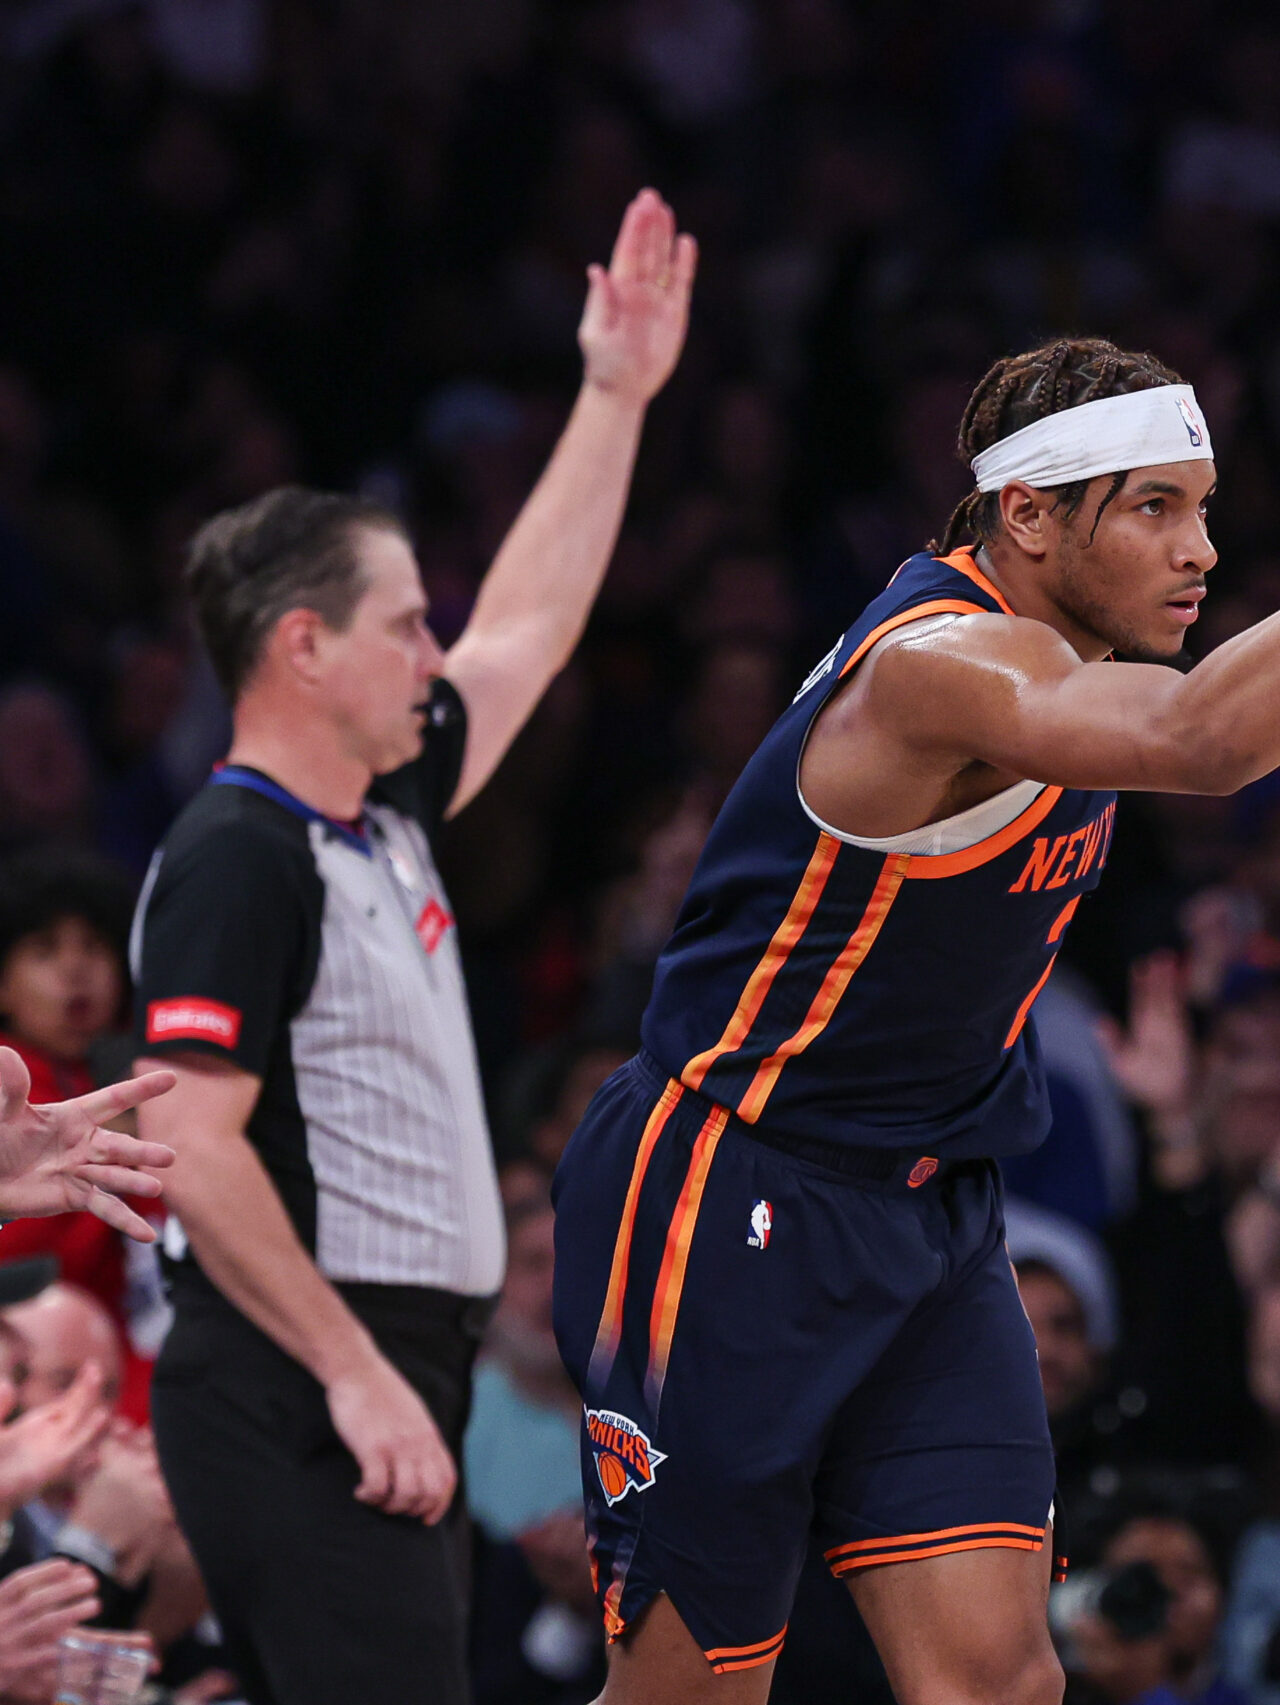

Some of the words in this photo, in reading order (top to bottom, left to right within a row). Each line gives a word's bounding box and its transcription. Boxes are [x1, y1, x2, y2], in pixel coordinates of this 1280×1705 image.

[1007, 812, 1104, 893] NEW
[589, 1415, 652, 1481] KNICKS
[600, 1413, 615, 1426] NEW
[616, 1418, 635, 1436] YORK
